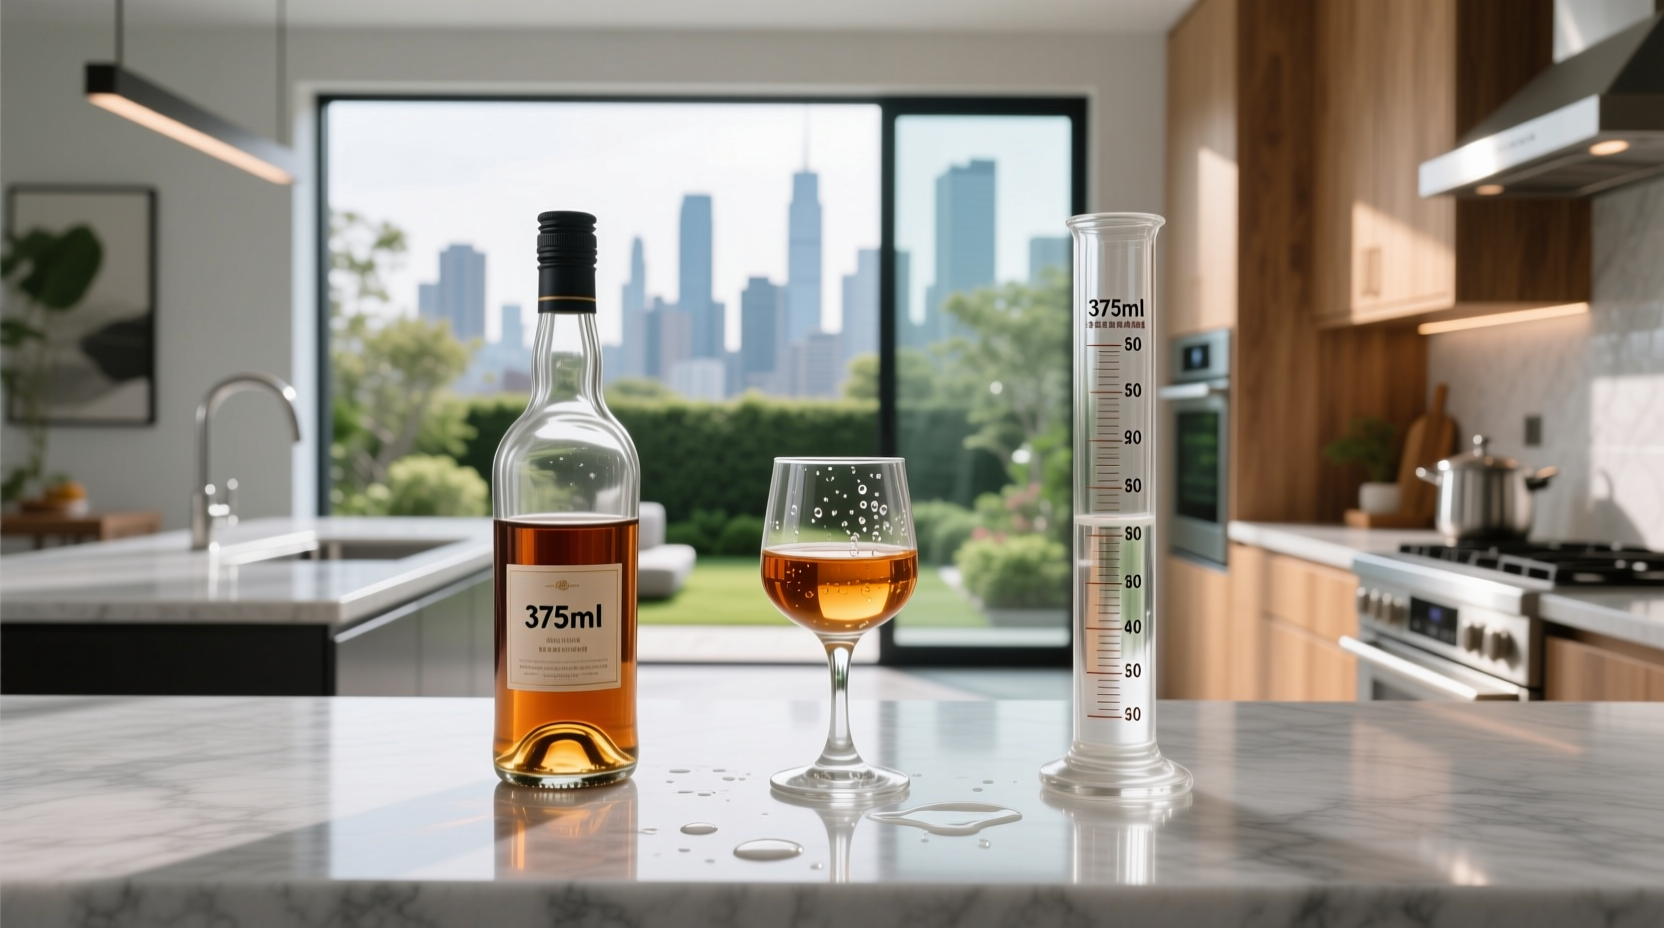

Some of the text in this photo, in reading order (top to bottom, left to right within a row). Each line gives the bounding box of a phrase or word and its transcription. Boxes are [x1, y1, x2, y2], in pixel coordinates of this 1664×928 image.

[1088, 298, 1145, 318] 375ml
[525, 604, 602, 629] 375ml
[1124, 619, 1142, 634] 40
